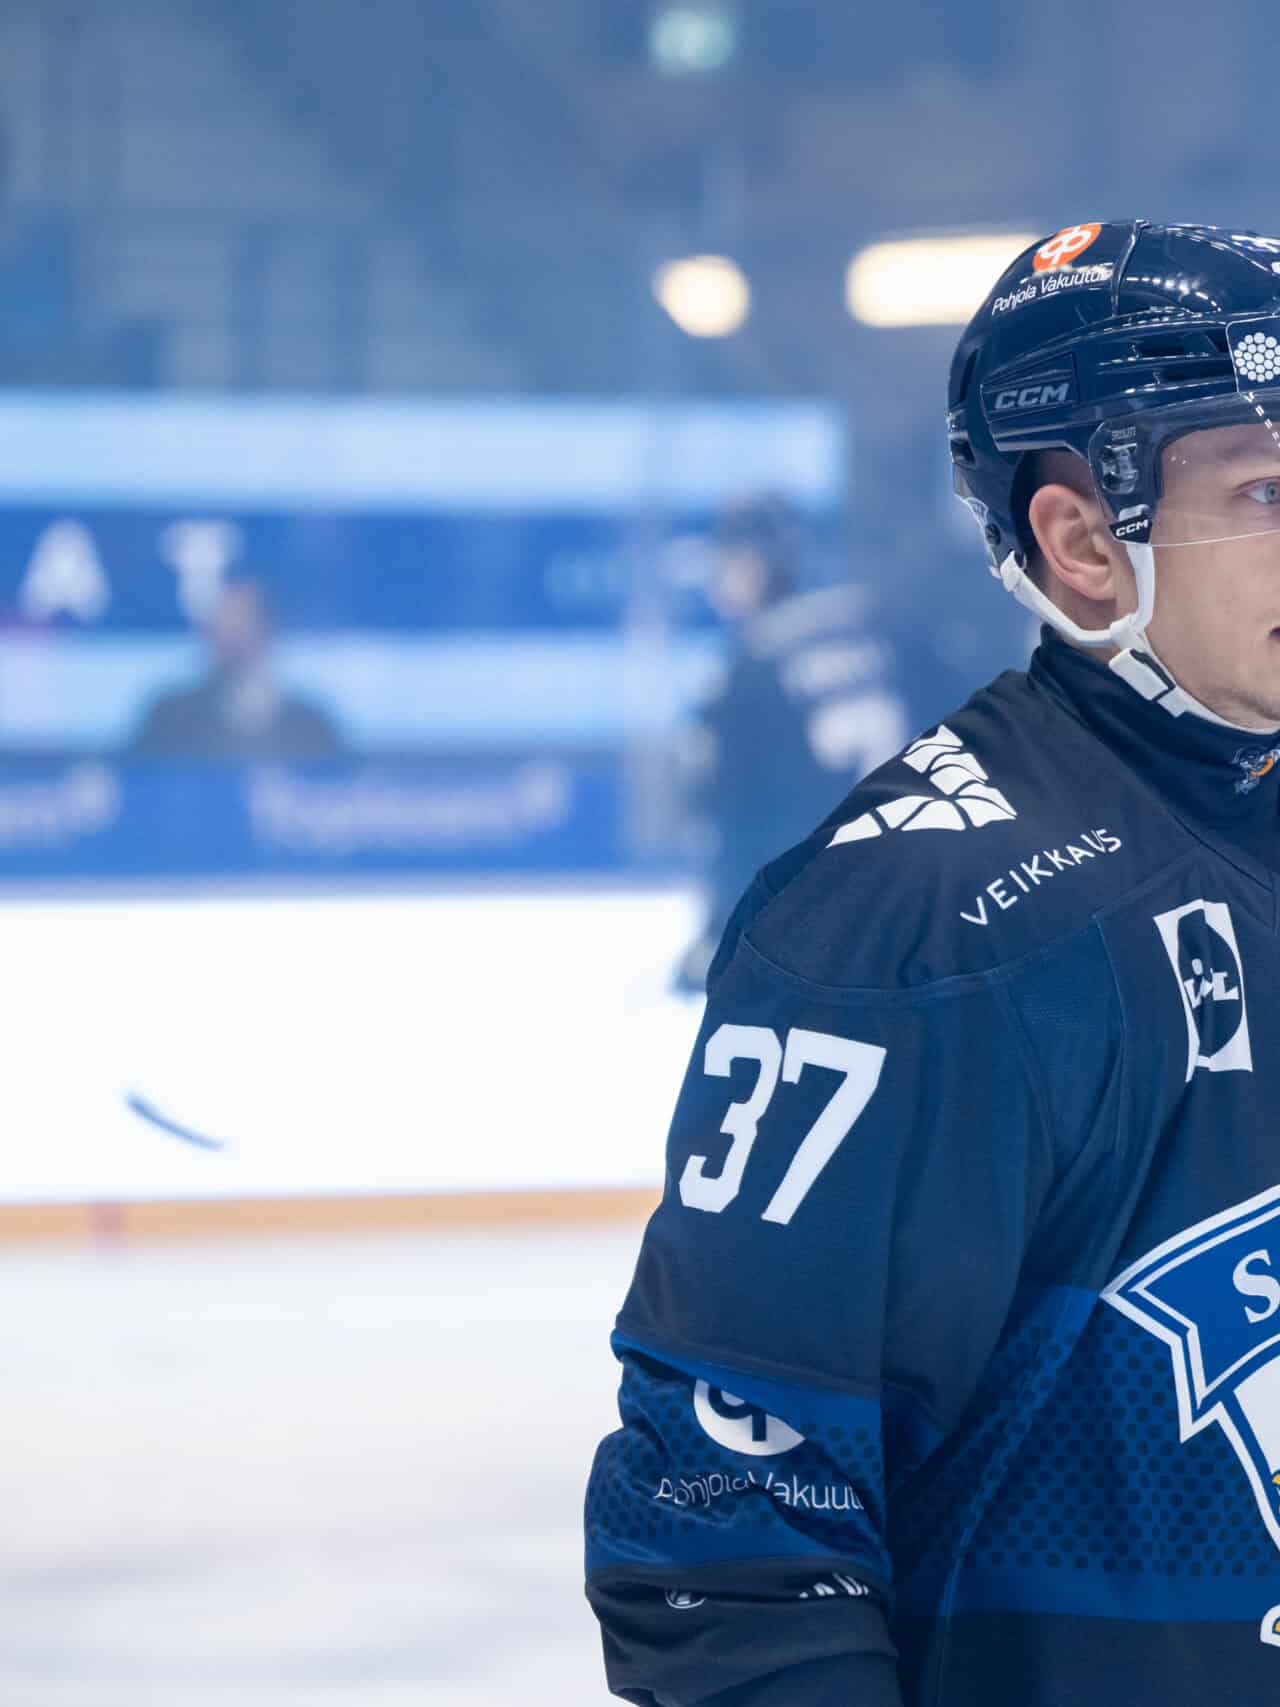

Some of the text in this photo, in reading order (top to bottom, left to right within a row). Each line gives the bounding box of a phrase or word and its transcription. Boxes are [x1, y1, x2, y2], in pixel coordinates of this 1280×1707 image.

[992, 284, 1037, 316] Pohjola
[994, 383, 1071, 410] CCM
[1115, 519, 1149, 537] CCM
[959, 828, 1122, 926] VEIKKAUS
[679, 1023, 888, 1225] 37
